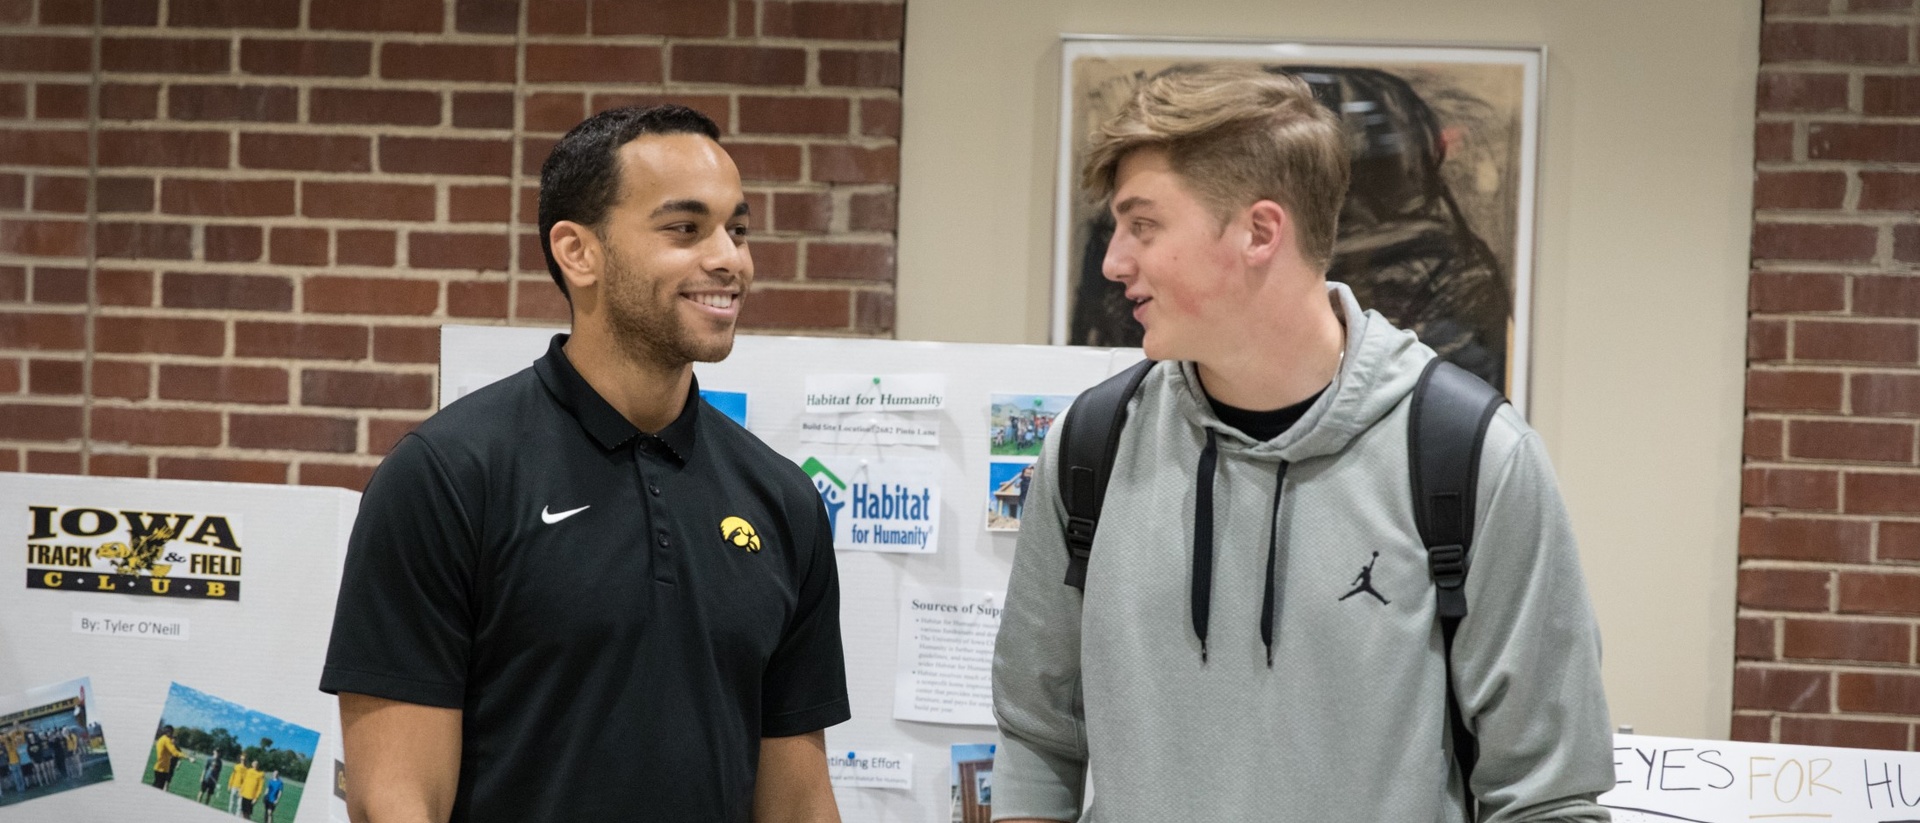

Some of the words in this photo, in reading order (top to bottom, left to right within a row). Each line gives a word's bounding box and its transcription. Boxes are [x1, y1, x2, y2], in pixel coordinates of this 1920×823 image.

[807, 394, 851, 406] Habitat
[855, 393, 875, 406] for
[880, 393, 943, 407] Humanity
[802, 423, 821, 431] Build
[852, 483, 930, 521] Habitat
[27, 505, 242, 552] IOWA
[852, 524, 869, 544] for
[27, 543, 92, 568] TRACK
[164, 552, 187, 564] &
[190, 554, 242, 576] FIELD
[911, 599, 958, 612] Sources
[962, 604, 974, 614] of
[81, 618, 100, 631] By:
[104, 619, 134, 634] Tyler
[138, 621, 180, 636] O'Neill
[871, 757, 901, 769] Effort
[1749, 756, 1843, 803] FOR
